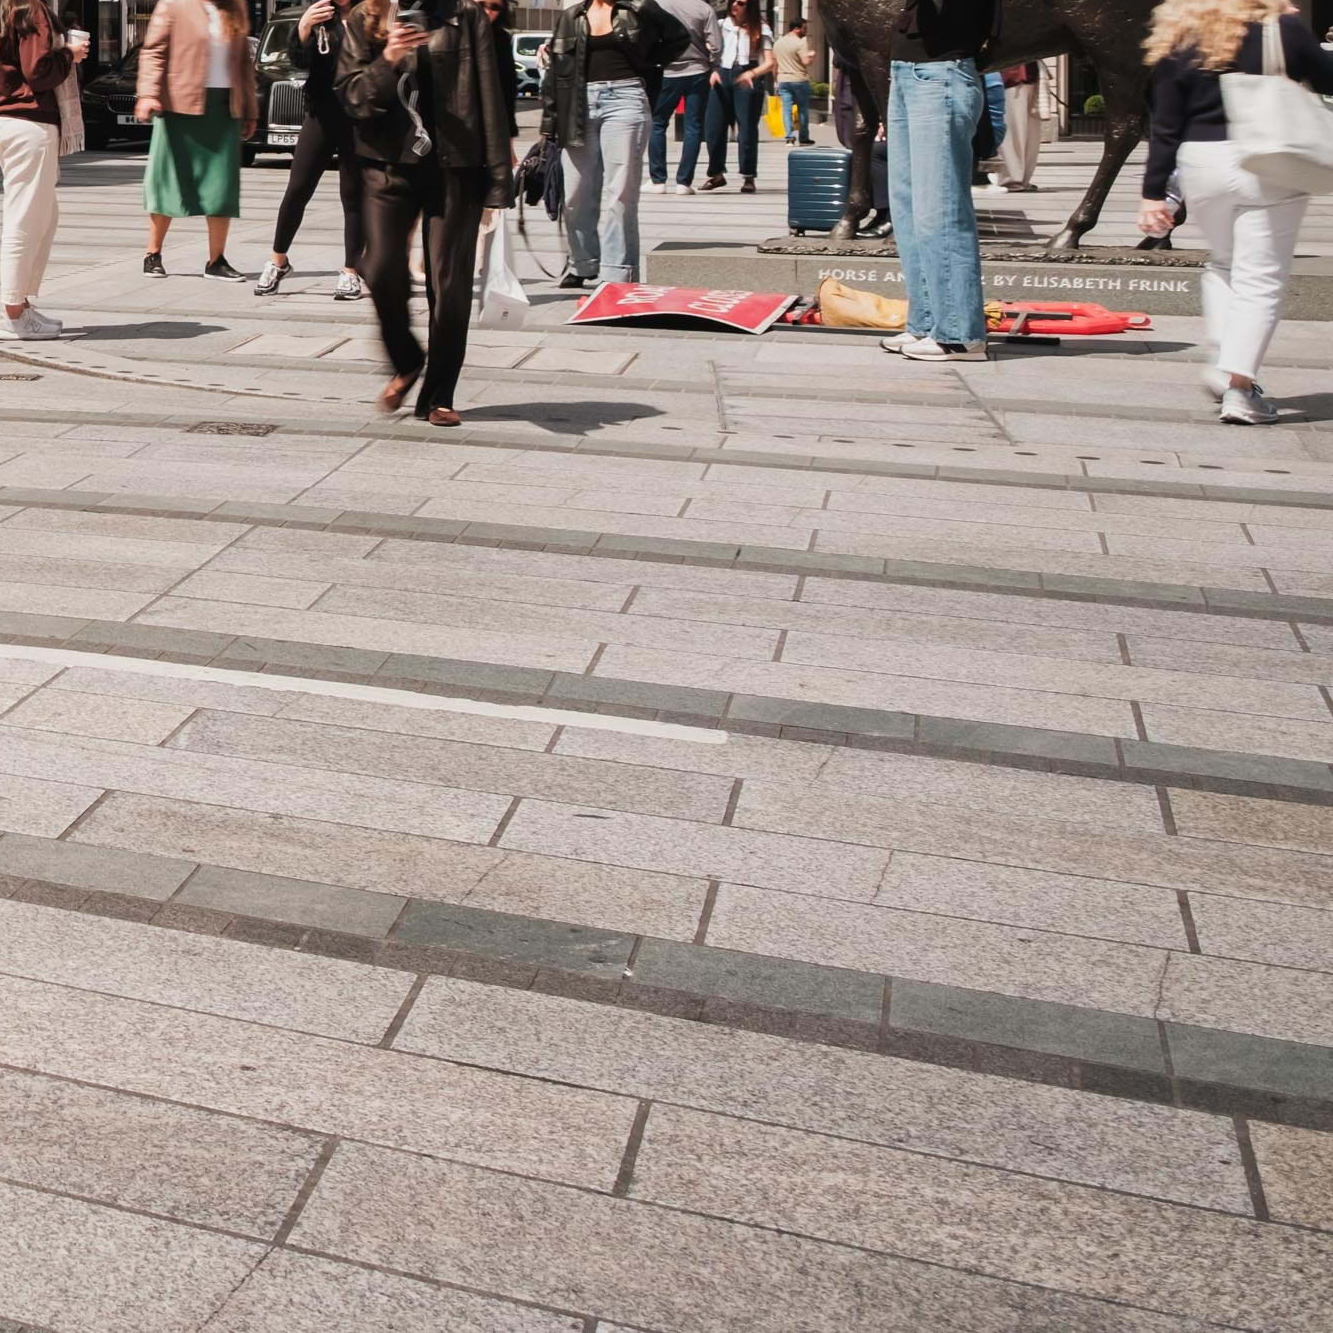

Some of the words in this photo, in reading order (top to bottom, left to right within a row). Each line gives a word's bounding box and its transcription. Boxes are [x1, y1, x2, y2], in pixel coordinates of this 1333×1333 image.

[272, 135, 295, 144] LP65
[818, 268, 877, 282] HORSE
[883, 271, 906, 282] AN
[993, 275, 1017, 286] BY
[1022, 275, 1122, 291] ELISABETH
[1128, 278, 1191, 293] FRINK
